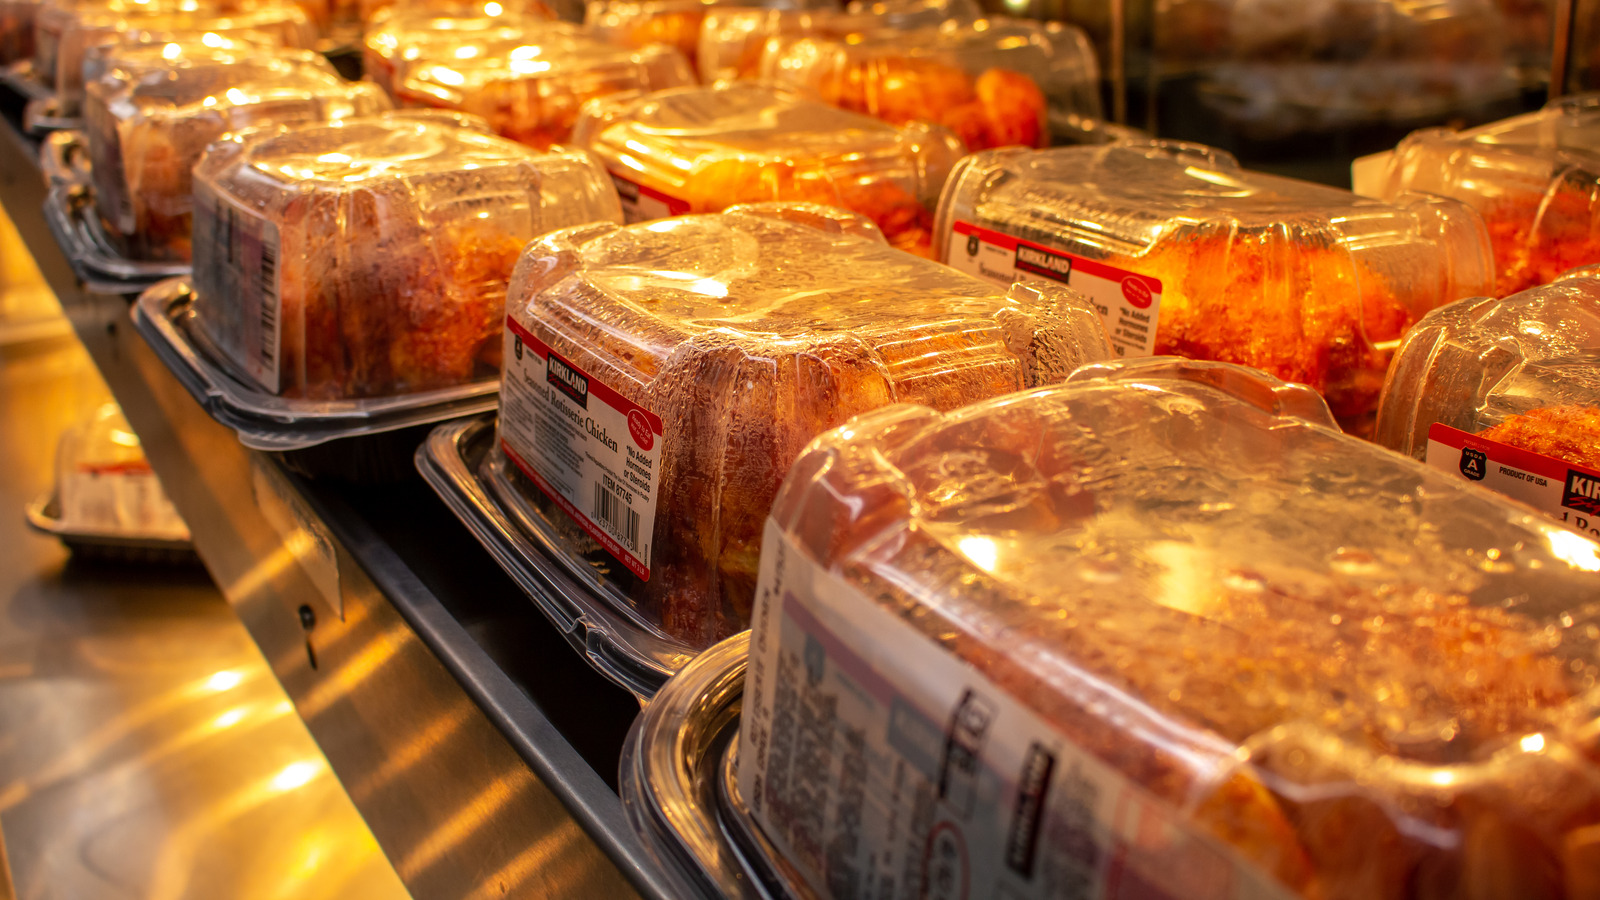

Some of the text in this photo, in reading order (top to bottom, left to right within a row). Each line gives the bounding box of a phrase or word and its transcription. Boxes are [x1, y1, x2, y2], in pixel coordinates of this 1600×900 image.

[549, 356, 587, 395] KIRKLAND
[523, 367, 550, 402] Seasoned
[550, 390, 584, 428] Rotisserie
[585, 416, 618, 453] Chicken
[635, 451, 652, 469] Added
[1465, 450, 1483, 461] USDA
[1467, 459, 1478, 471] A
[626, 456, 651, 480] Hormones
[1463, 468, 1480, 478] GRADE
[1499, 466, 1547, 487] PRODUCT OF USA
[602, 473, 632, 505] ITEM 87745
[623, 469, 650, 493] or Steroids
